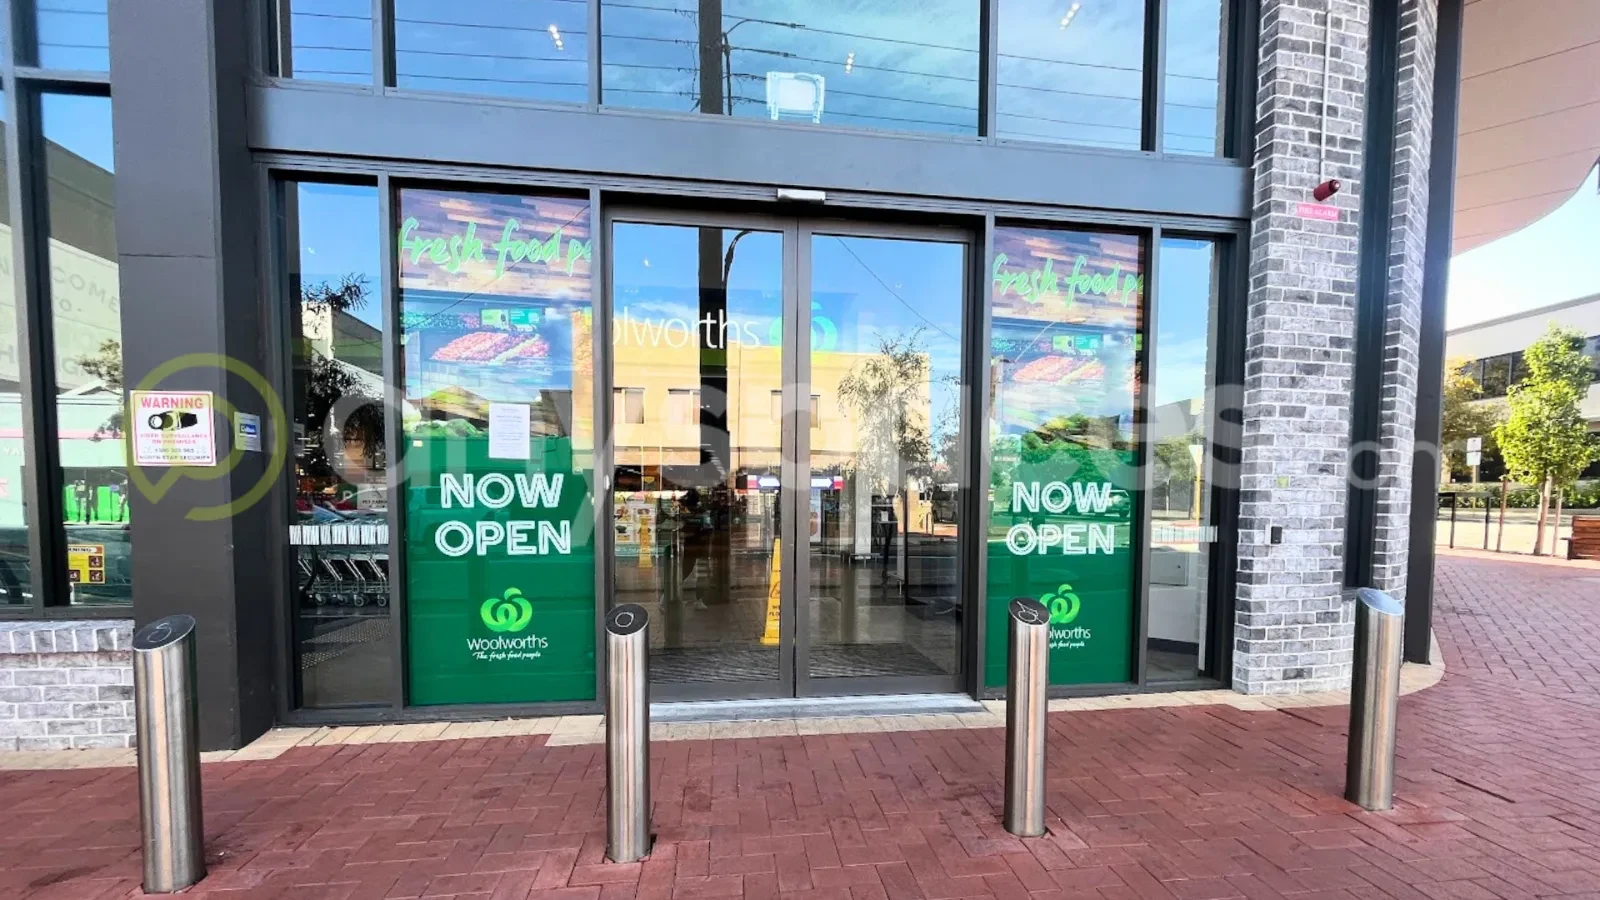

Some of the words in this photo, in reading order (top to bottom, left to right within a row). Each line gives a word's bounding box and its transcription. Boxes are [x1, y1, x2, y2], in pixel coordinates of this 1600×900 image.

[398, 216, 485, 274] fresh
[492, 217, 561, 279] food
[991, 252, 1059, 304] fresh
[1064, 254, 1121, 309] food
[613, 306, 761, 349] lworths
[141, 397, 204, 409] WARNING
[439, 472, 564, 509] NOW
[1012, 480, 1112, 514] NOW
[434, 519, 572, 557] OPEN
[1005, 523, 1115, 556] OPEN
[466, 634, 548, 650] Woolworths
[1049, 626, 1091, 639] lworths
[472, 651, 488, 660] The
[489, 651, 506, 661] fresh
[507, 651, 522, 660] food
[522, 651, 541, 660] people
